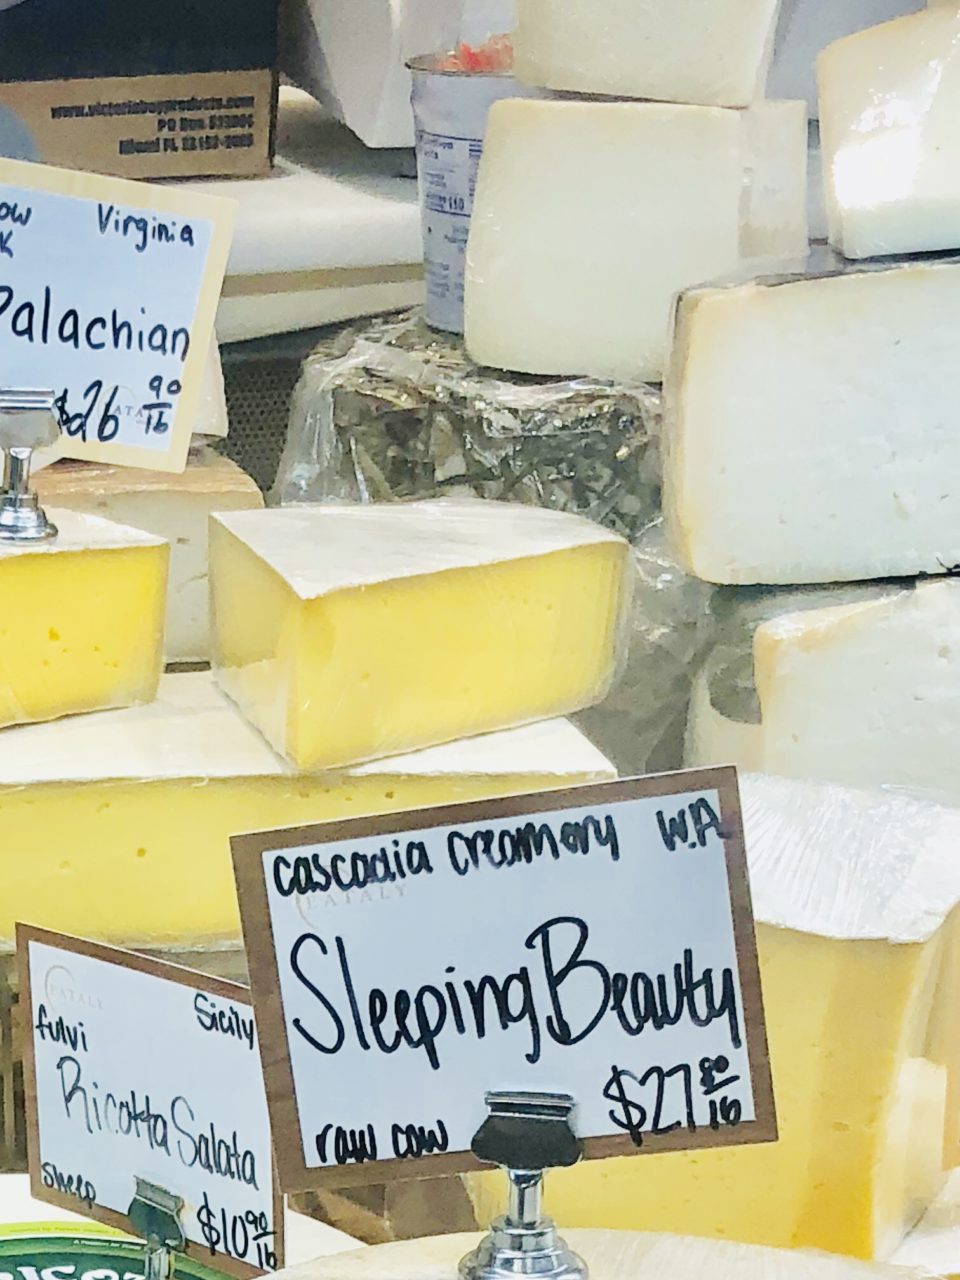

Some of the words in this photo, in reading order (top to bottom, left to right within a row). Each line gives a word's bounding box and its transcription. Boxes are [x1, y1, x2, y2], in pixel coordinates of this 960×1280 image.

[97, 202, 195, 252] Virginia
[194, 992, 254, 1050] Sicily
[290, 931, 542, 1070] Sleeping
[525, 915, 742, 1049] Beauty
[56, 1055, 172, 1157] Ricotta
[171, 1096, 260, 1191] Salata
[603, 1065, 696, 1147] $27
[315, 1124, 377, 1164] raw
[391, 1121, 449, 1156] cow
[197, 1192, 248, 1260] $10
